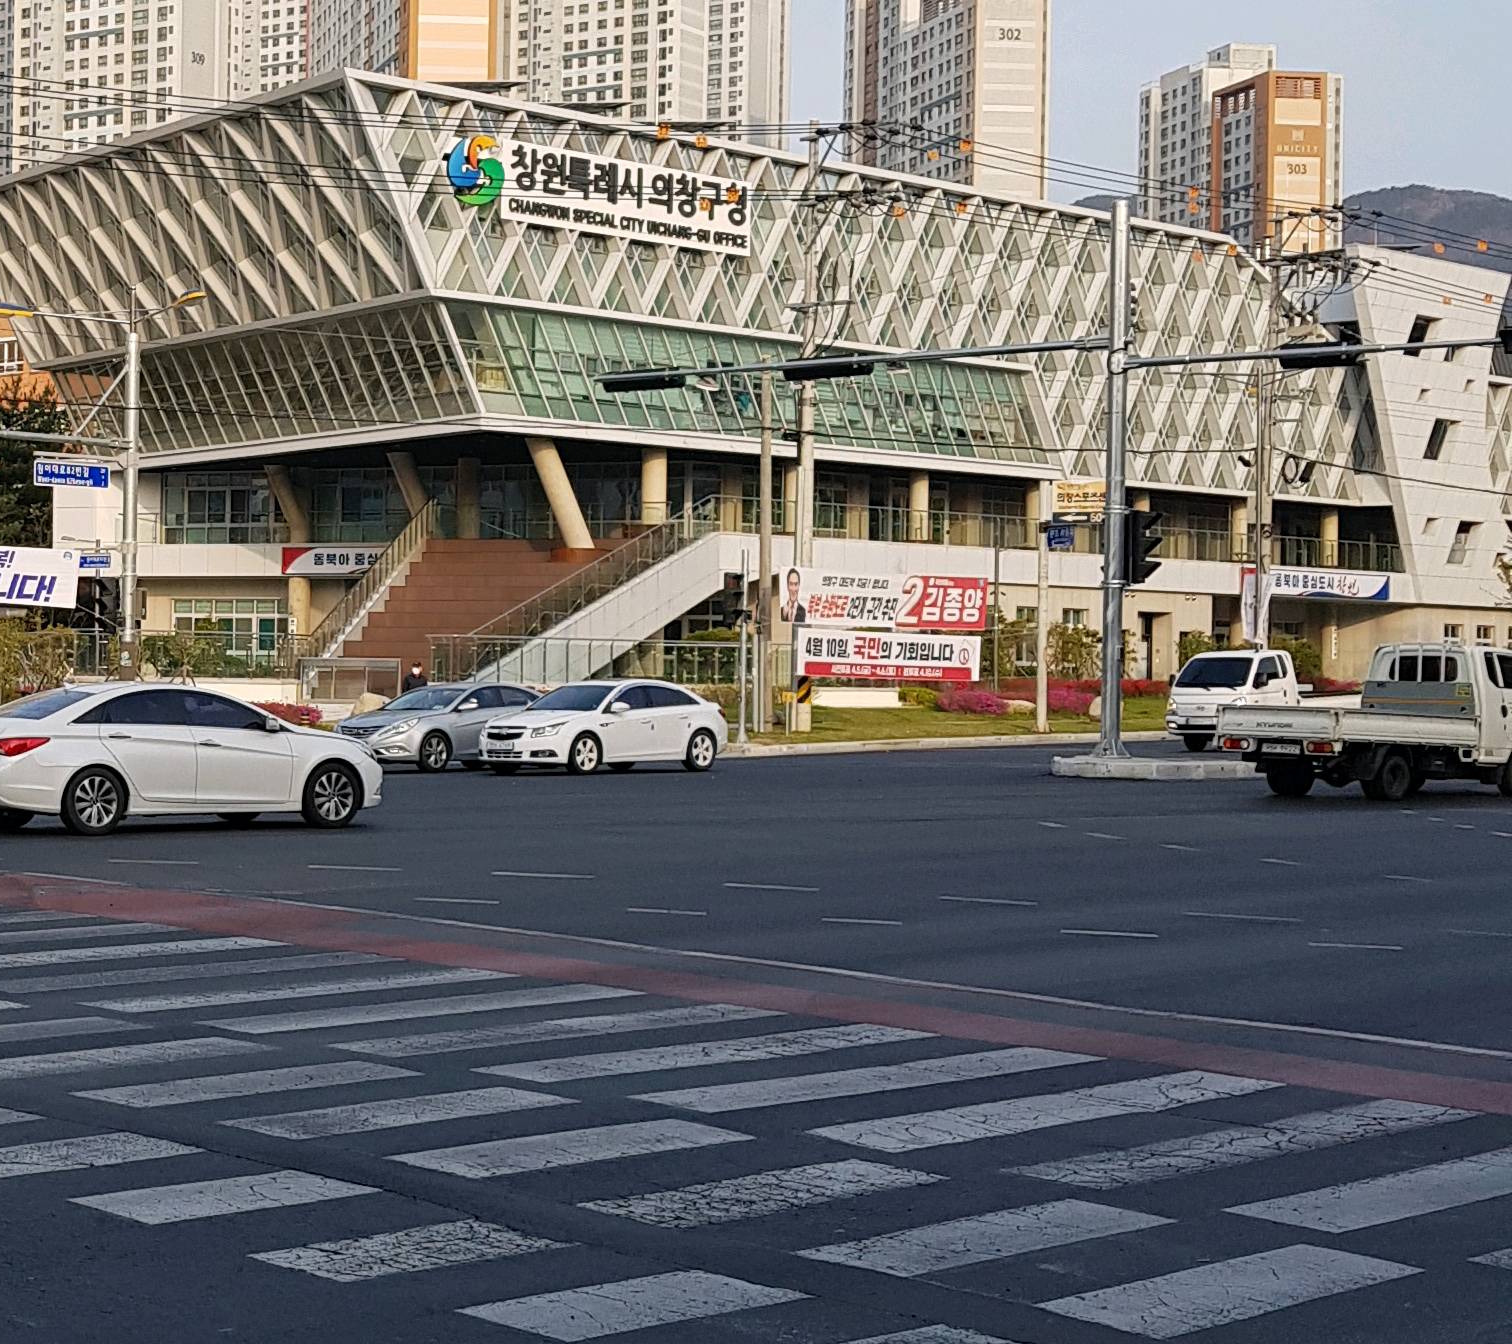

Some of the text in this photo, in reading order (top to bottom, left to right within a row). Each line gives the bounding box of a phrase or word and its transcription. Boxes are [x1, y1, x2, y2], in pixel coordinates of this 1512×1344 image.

[998, 27, 1022, 41] 302
[191, 51, 206, 66] 309
[1287, 163, 1308, 175] 303
[510, 144, 749, 227] 창원특례시 의창구청
[508, 197, 749, 249] CHANGWON SPECIAL CITY UICHANG-GU OFFICE
[313, 552, 350, 566] 동북아
[1273, 573, 1301, 588] 동북아
[1302, 574, 1336, 590] 중심도시
[847, 596, 869, 619] 2단계
[867, 596, 884, 621] 구간
[893, 575, 925, 627] 2
[920, 587, 984, 623] 김종양
[805, 636, 954, 662] 4월 10일, 국민의 기회입니다
